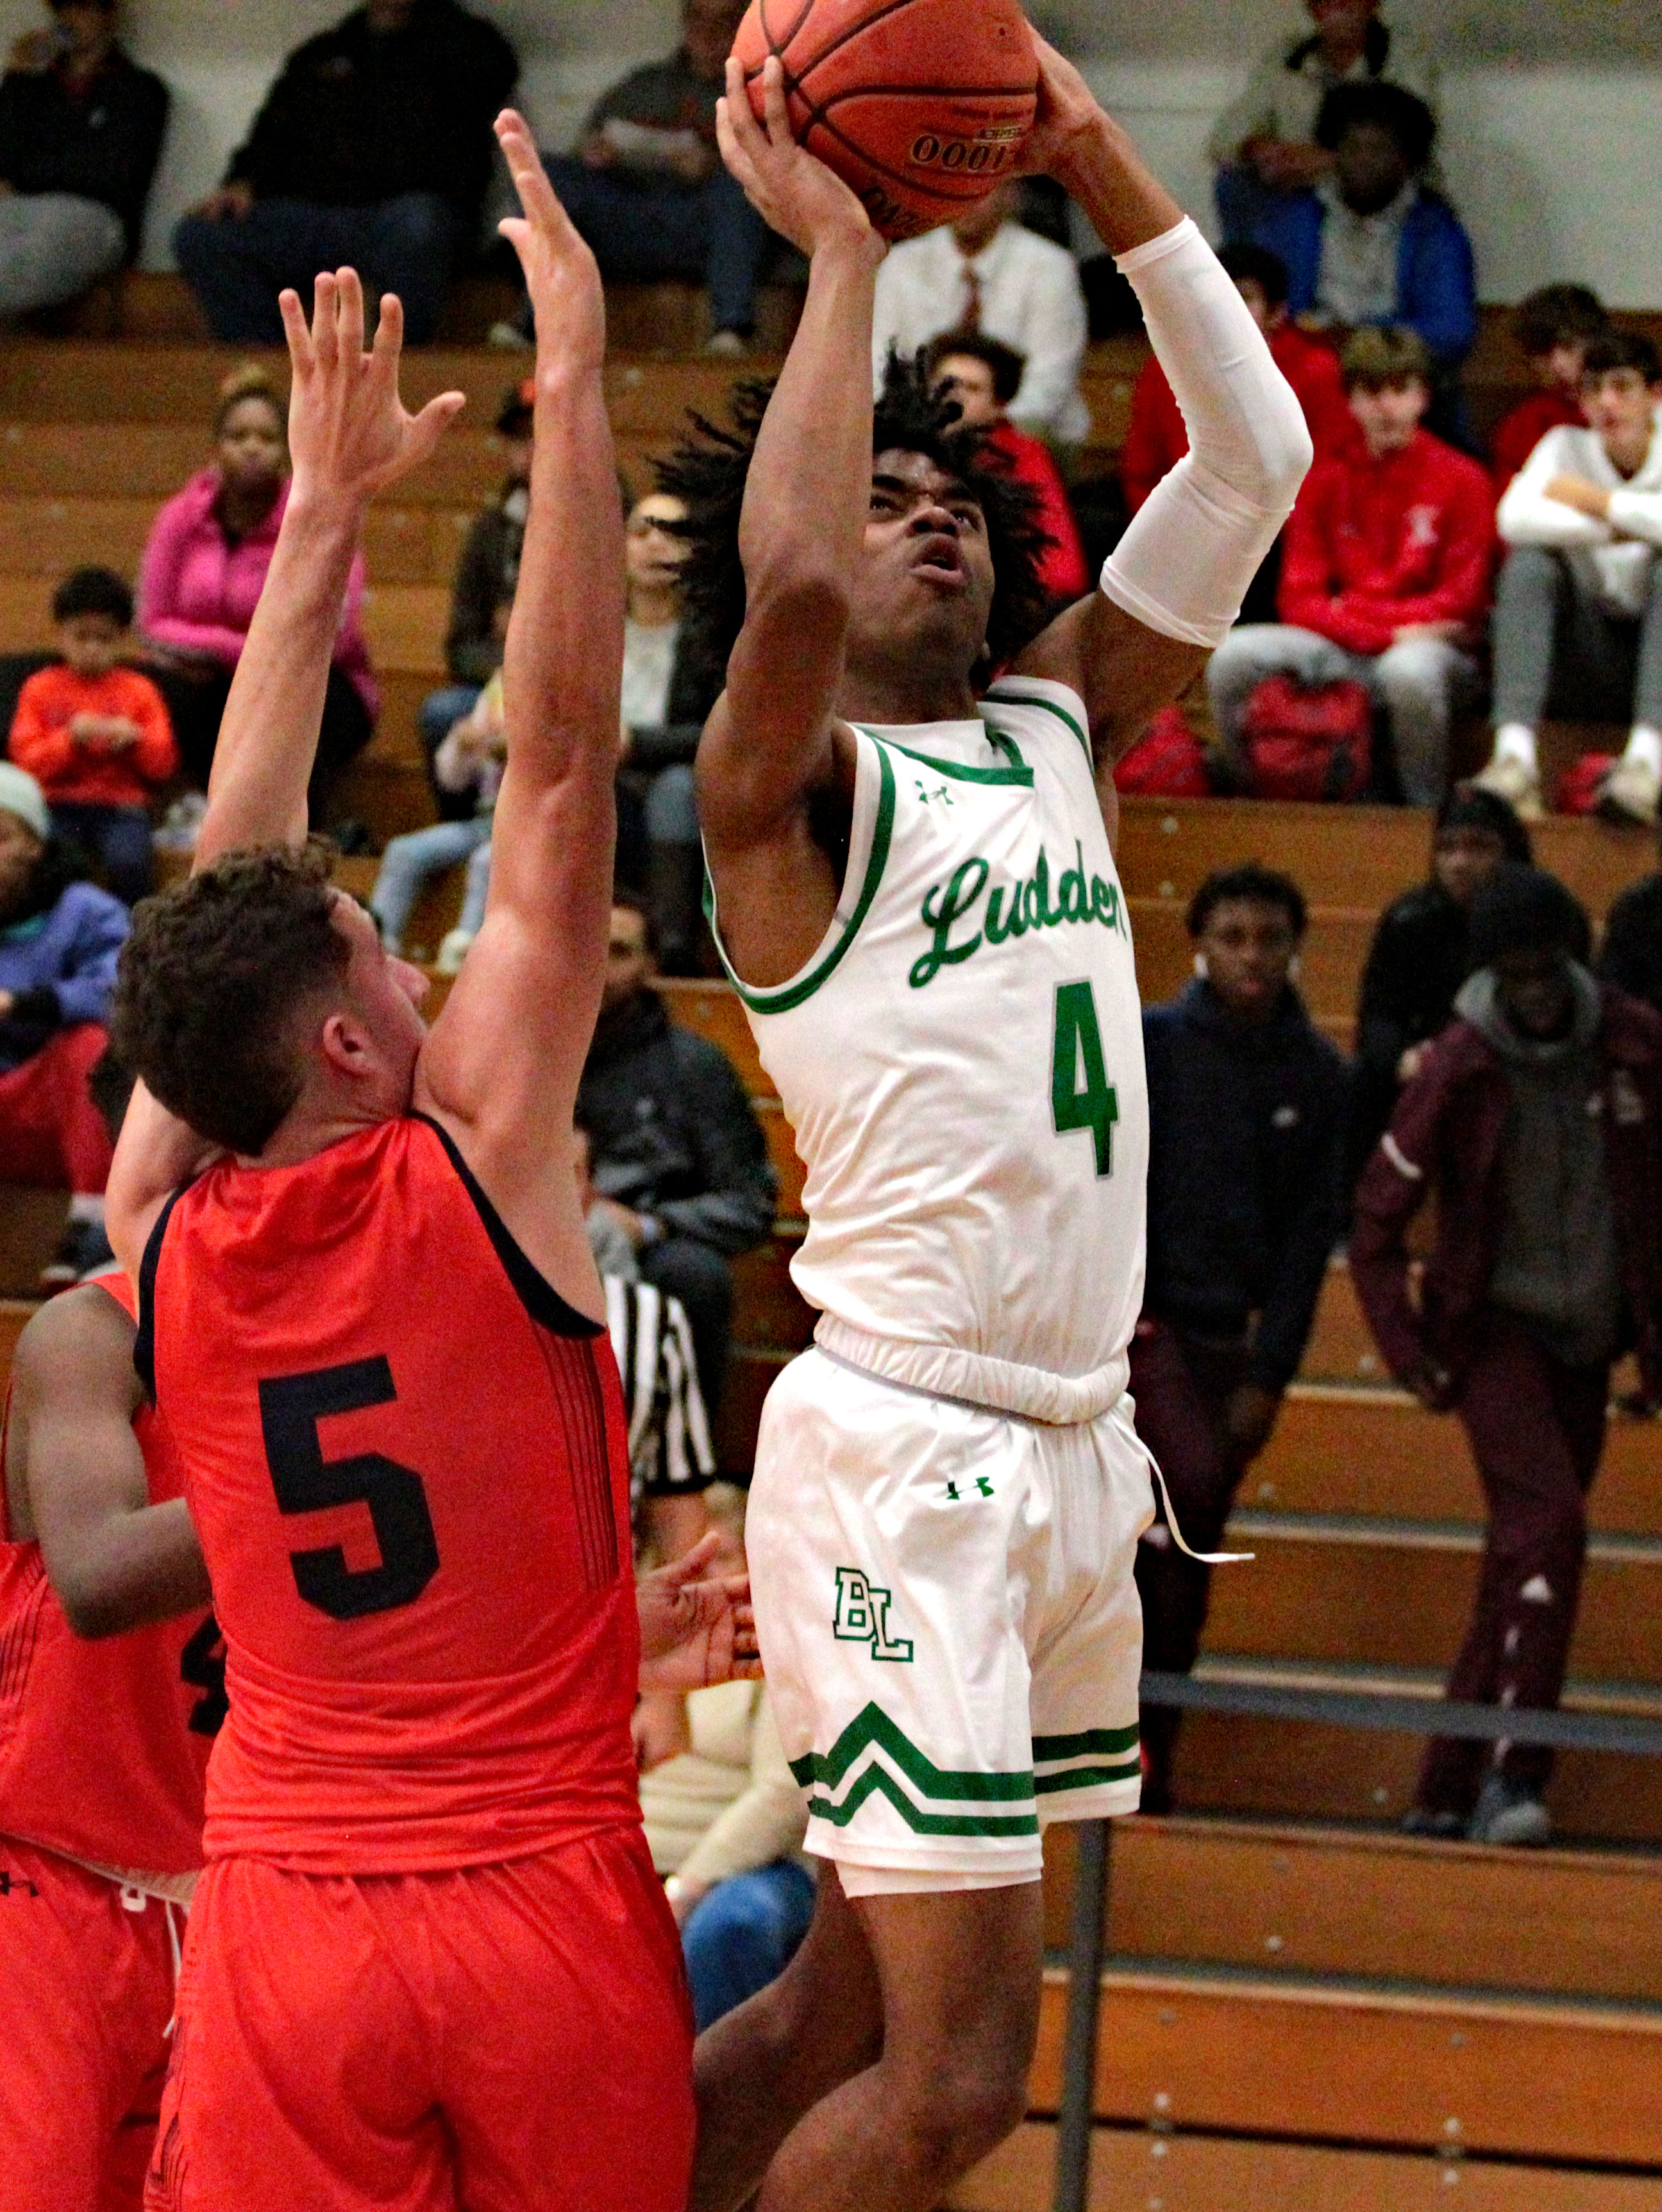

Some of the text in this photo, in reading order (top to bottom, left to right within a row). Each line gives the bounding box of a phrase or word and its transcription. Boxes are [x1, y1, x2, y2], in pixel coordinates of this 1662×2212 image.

[1050, 978, 1119, 1180] 4
[258, 1354, 441, 1620] 5
[833, 1566, 914, 1663] BL
